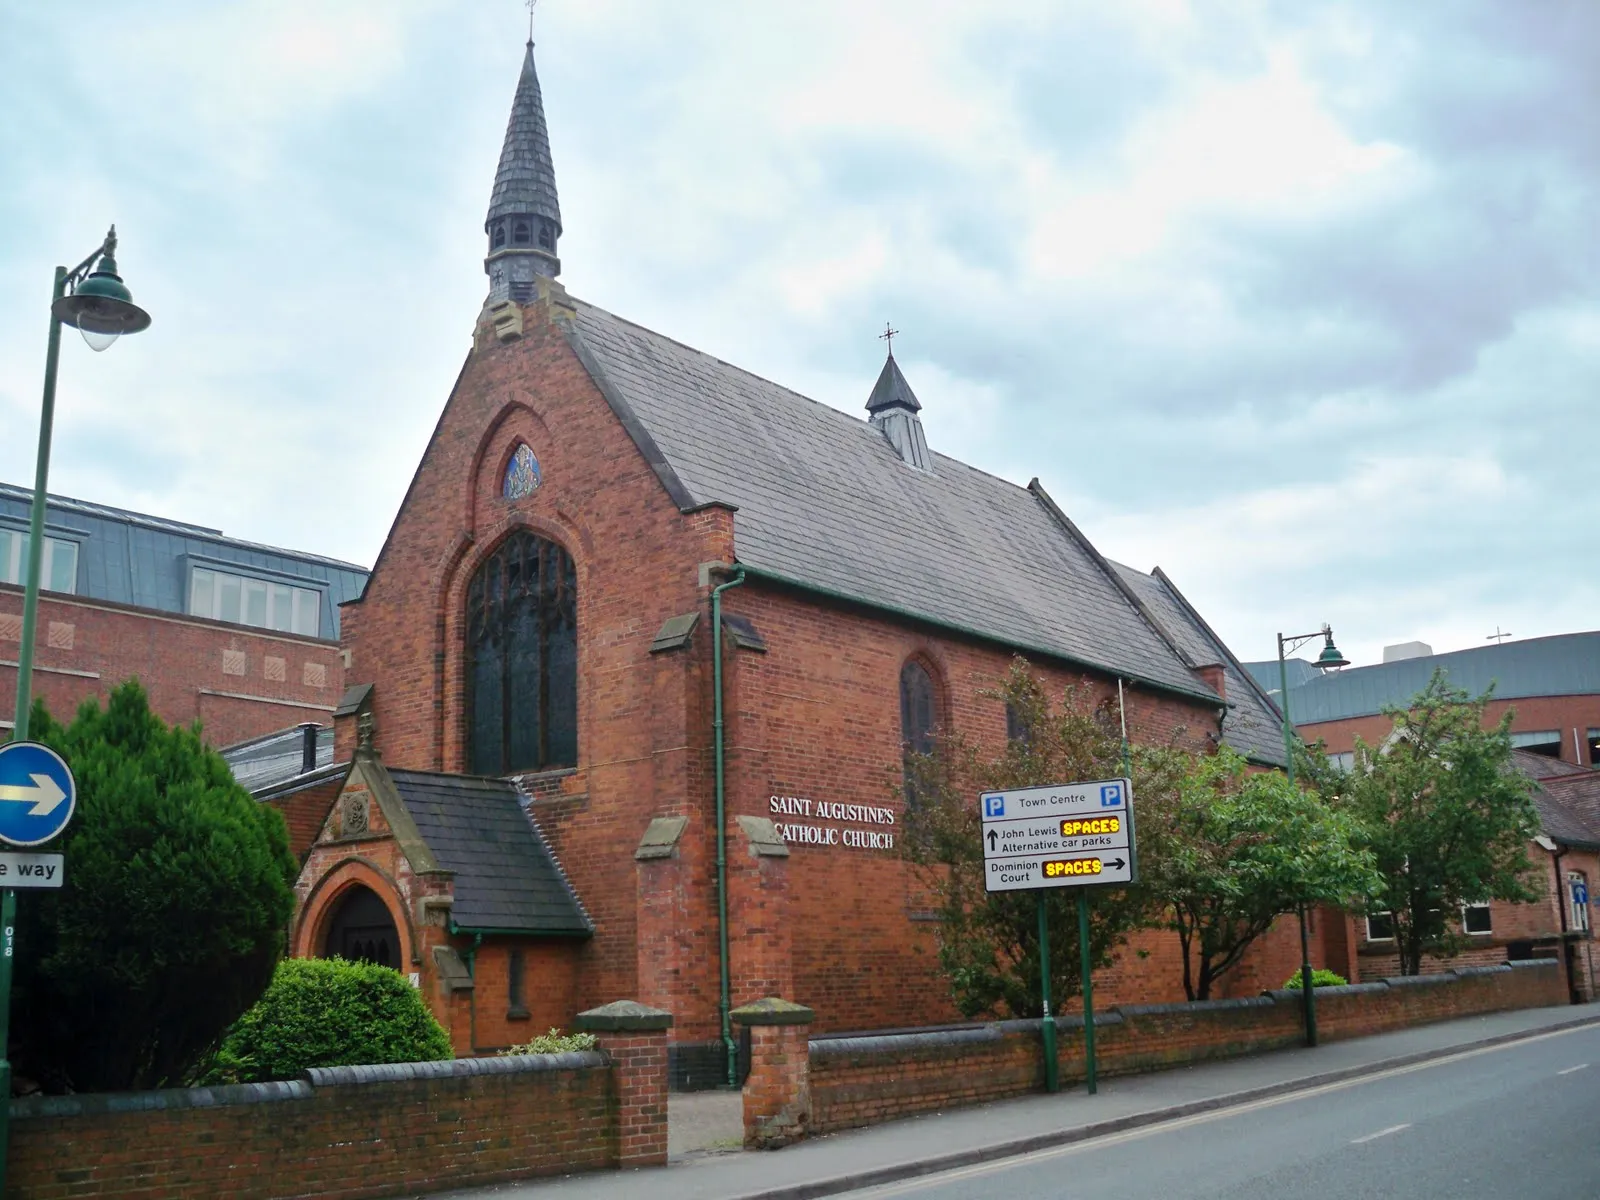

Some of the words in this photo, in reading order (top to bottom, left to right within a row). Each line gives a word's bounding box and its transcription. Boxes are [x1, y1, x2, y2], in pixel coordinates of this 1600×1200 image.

[770, 795, 812, 816] SAINT
[816, 801, 895, 825] AUGUSTINE'S
[1019, 798, 1046, 808] Town
[1050, 795, 1086, 805] Centre
[1001, 829, 1025, 839] John
[1028, 827, 1058, 837] Lewis
[1063, 818, 1120, 835] SPACES
[842, 829, 893, 849] CHURCH
[1002, 840, 1058, 853] Alternative
[1062, 839, 1078, 848] car
[1082, 836, 1112, 847] parks
[17, 864, 56, 880] way
[991, 861, 1038, 873] Dominion
[1046, 859, 1101, 876] SPACES
[1000, 872, 1030, 883] Court
